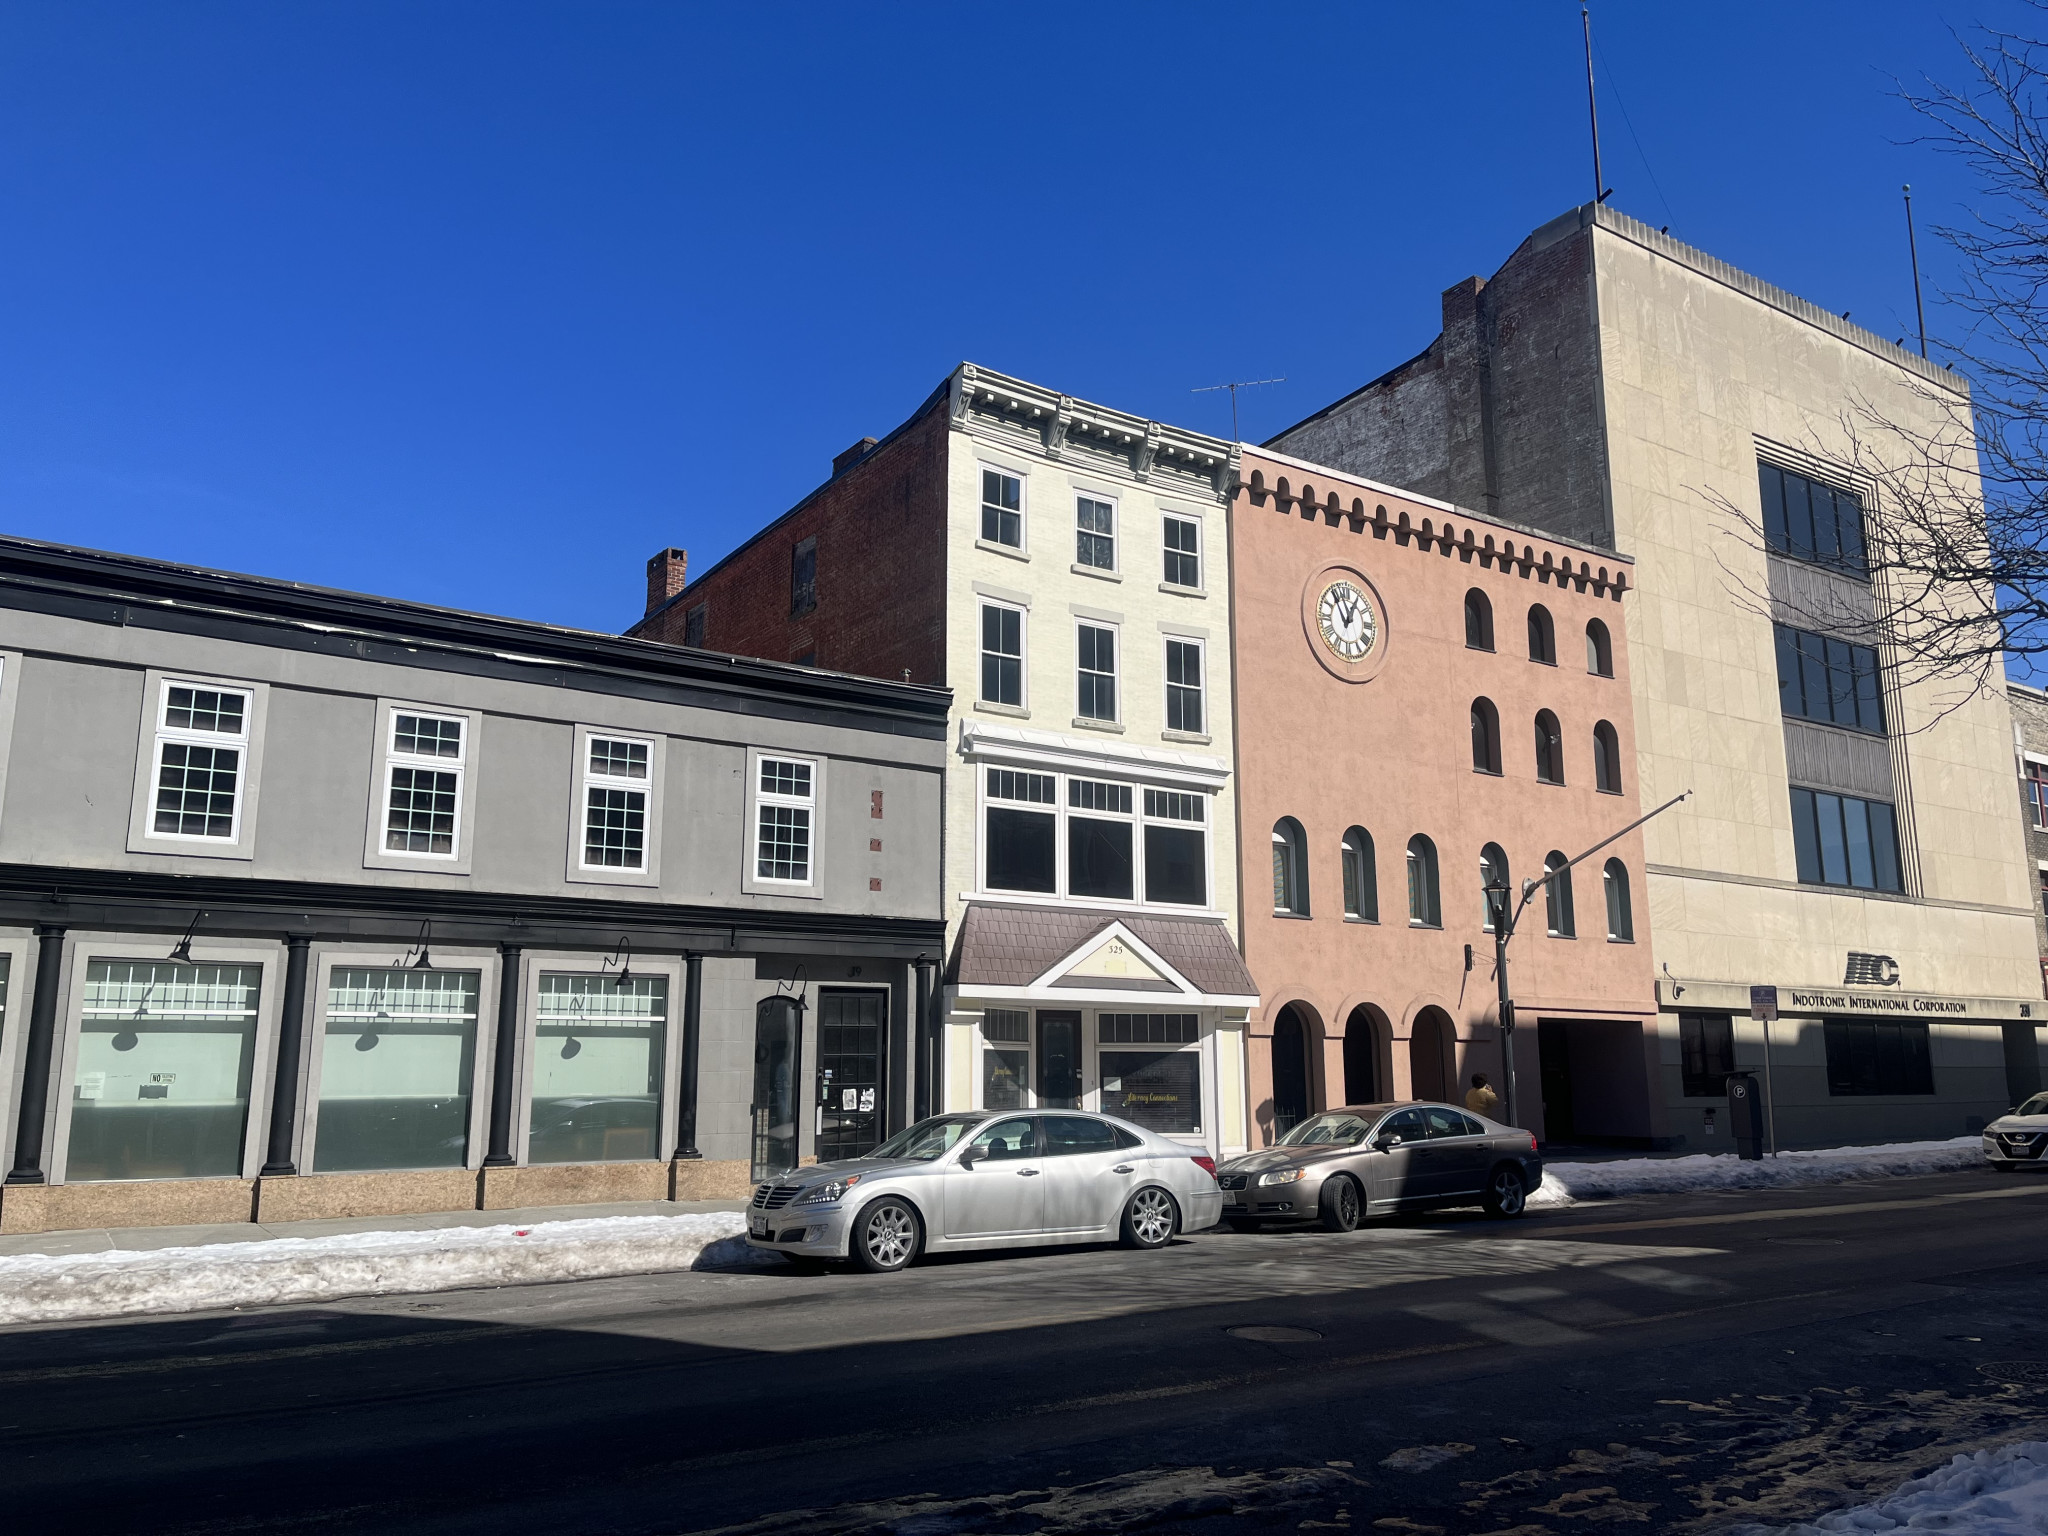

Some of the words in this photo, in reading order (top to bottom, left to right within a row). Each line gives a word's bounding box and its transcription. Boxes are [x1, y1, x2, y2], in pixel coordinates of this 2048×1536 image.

[1109, 946, 1123, 954] 325
[1792, 993, 1846, 1008] INDOTRONIX
[1850, 996, 1910, 1011] INTERNATIONAL
[1913, 999, 1966, 1013] CORPORATION
[152, 1074, 161, 1082] NO
